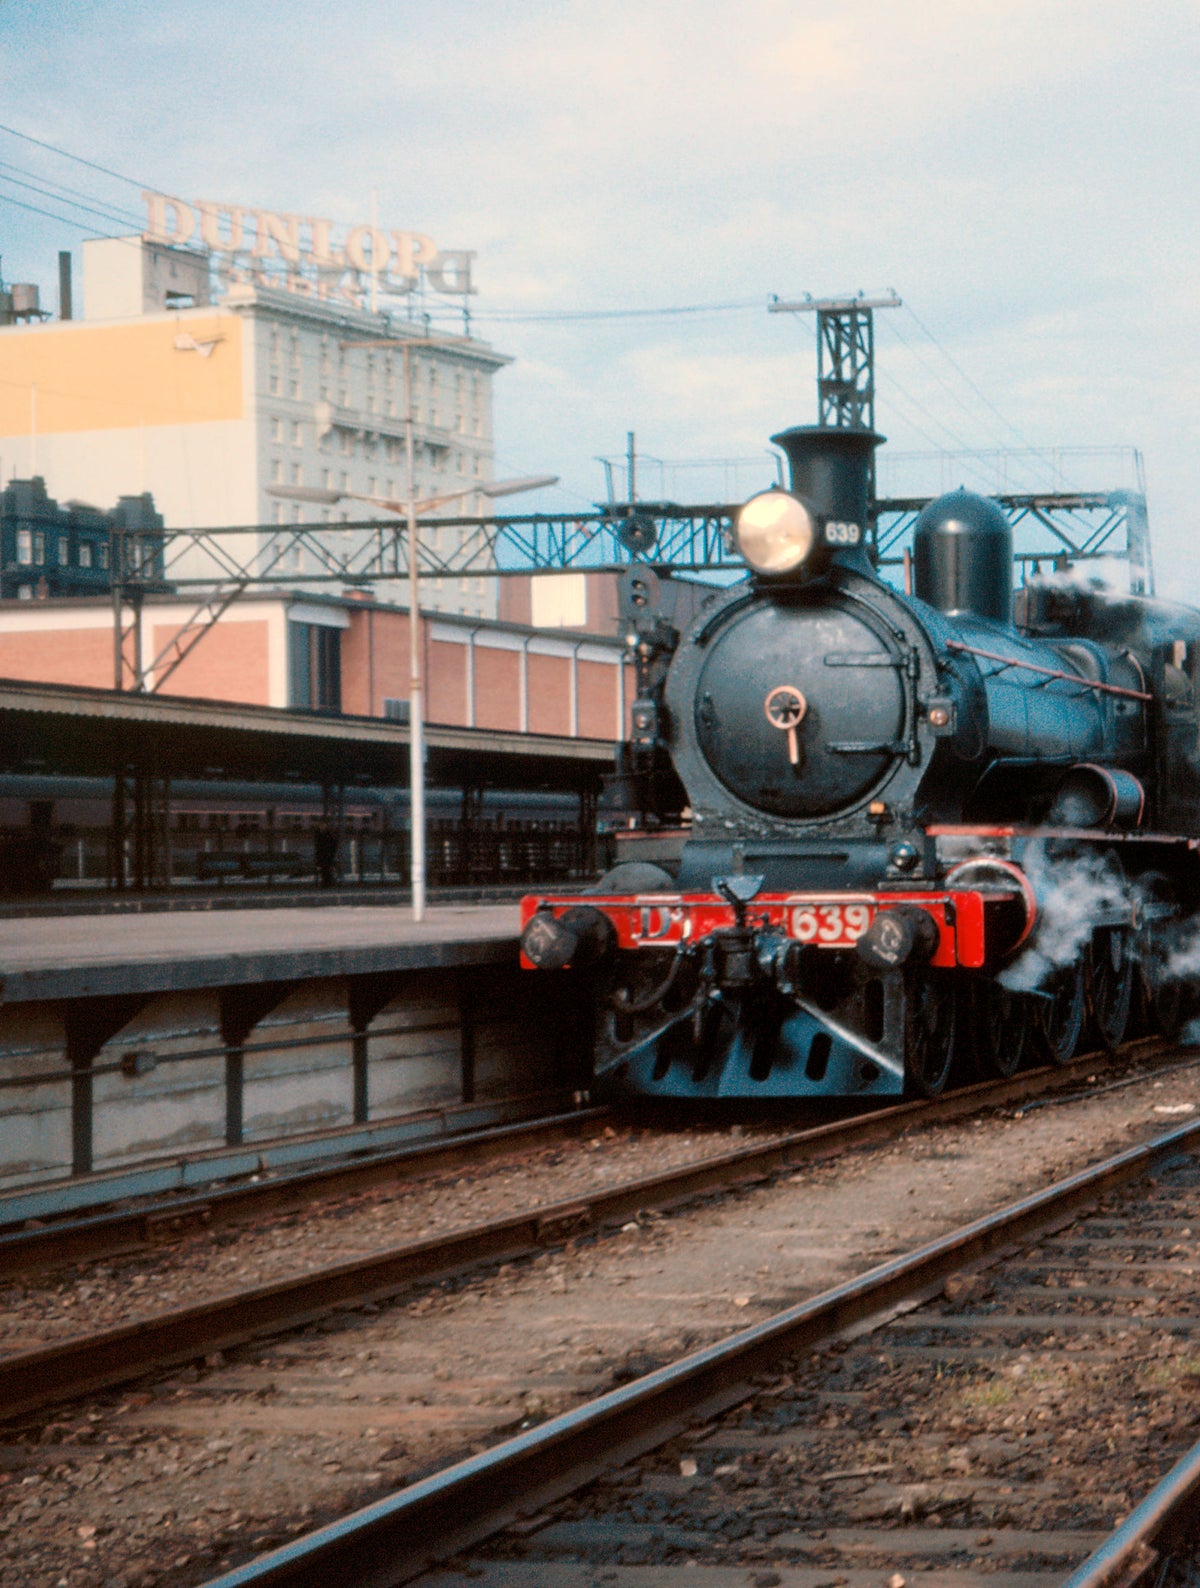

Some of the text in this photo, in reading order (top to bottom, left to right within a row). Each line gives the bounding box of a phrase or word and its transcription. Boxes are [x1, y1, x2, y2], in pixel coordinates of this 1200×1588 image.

[141, 190, 437, 278] DUNLOP
[825, 523, 860, 543] 639
[792, 905, 870, 941] 639
